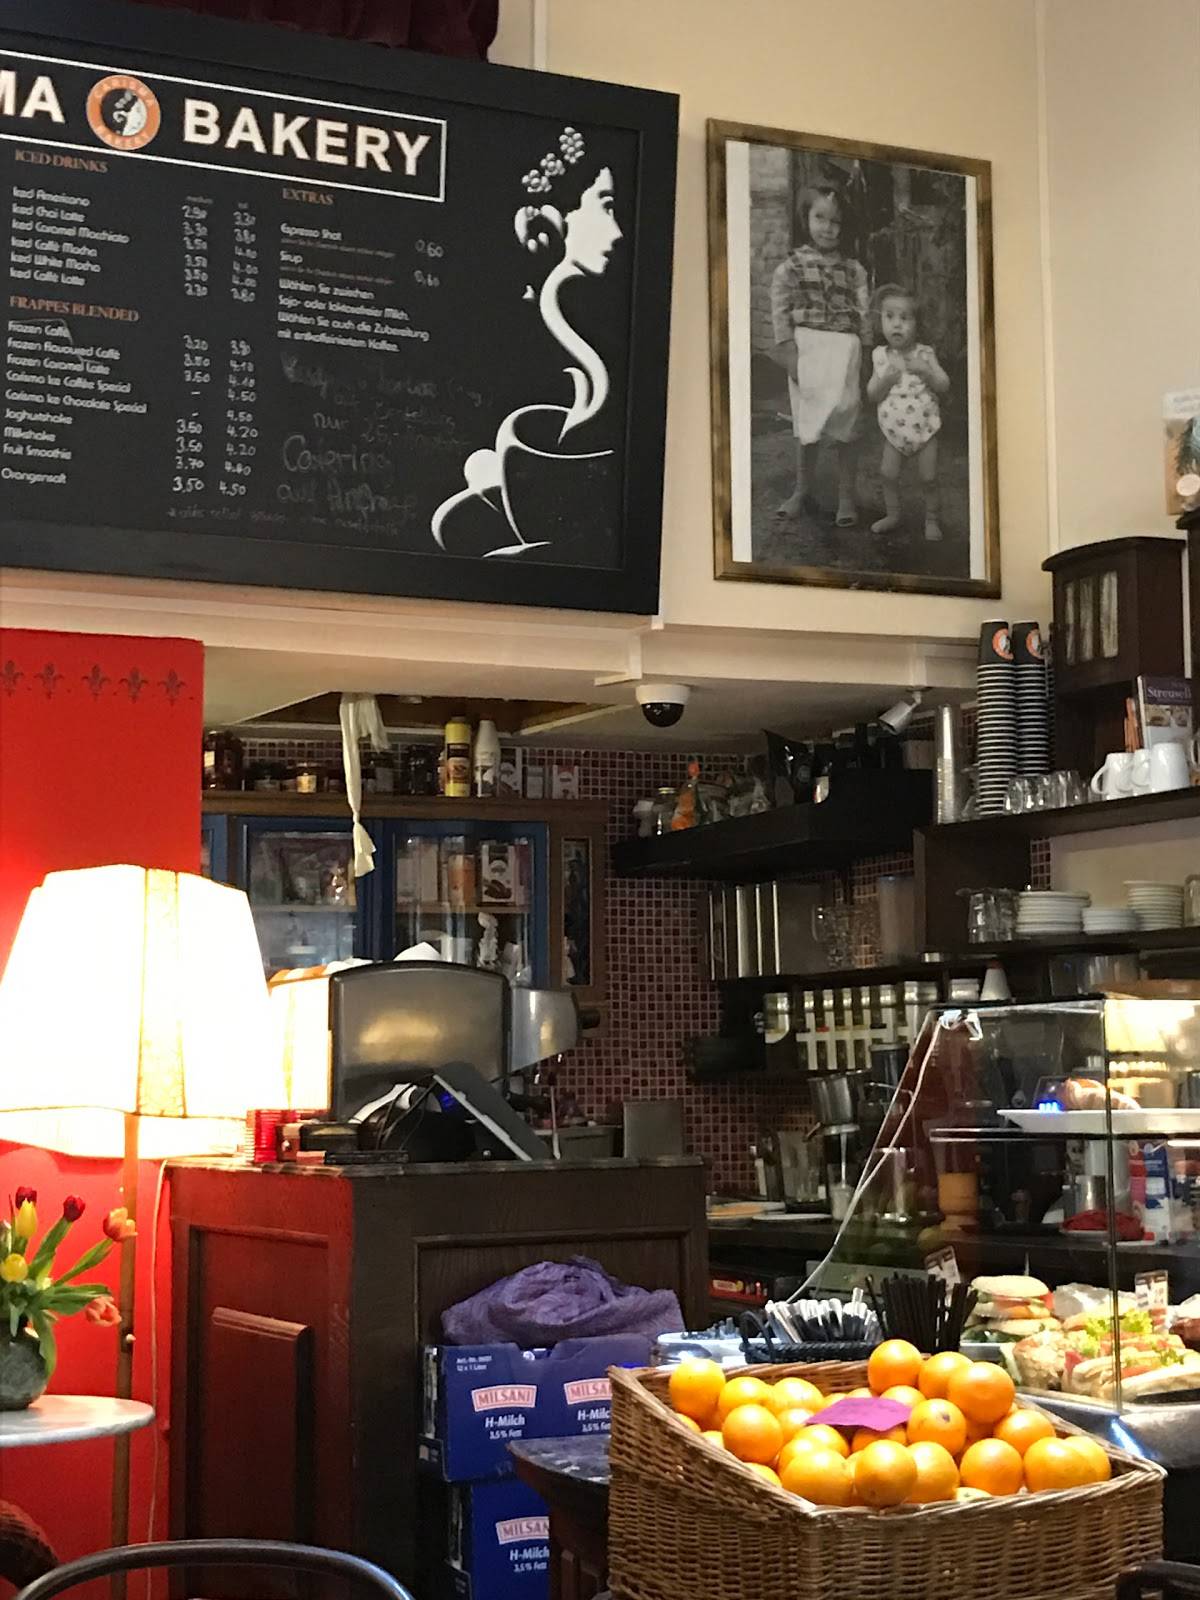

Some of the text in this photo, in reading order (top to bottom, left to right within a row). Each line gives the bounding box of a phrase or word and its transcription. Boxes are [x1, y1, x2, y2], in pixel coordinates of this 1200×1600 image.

[182, 98, 430, 176] BAKERY
[15, 149, 108, 173] ICED DRINKS
[282, 187, 334, 206] EXTRAS
[9, 296, 139, 321] FRAPPES BLENDED
[478, 1389, 531, 1405] MILSANI
[571, 1383, 611, 1398] MILSA
[485, 1414, 525, 1428] H-Milch
